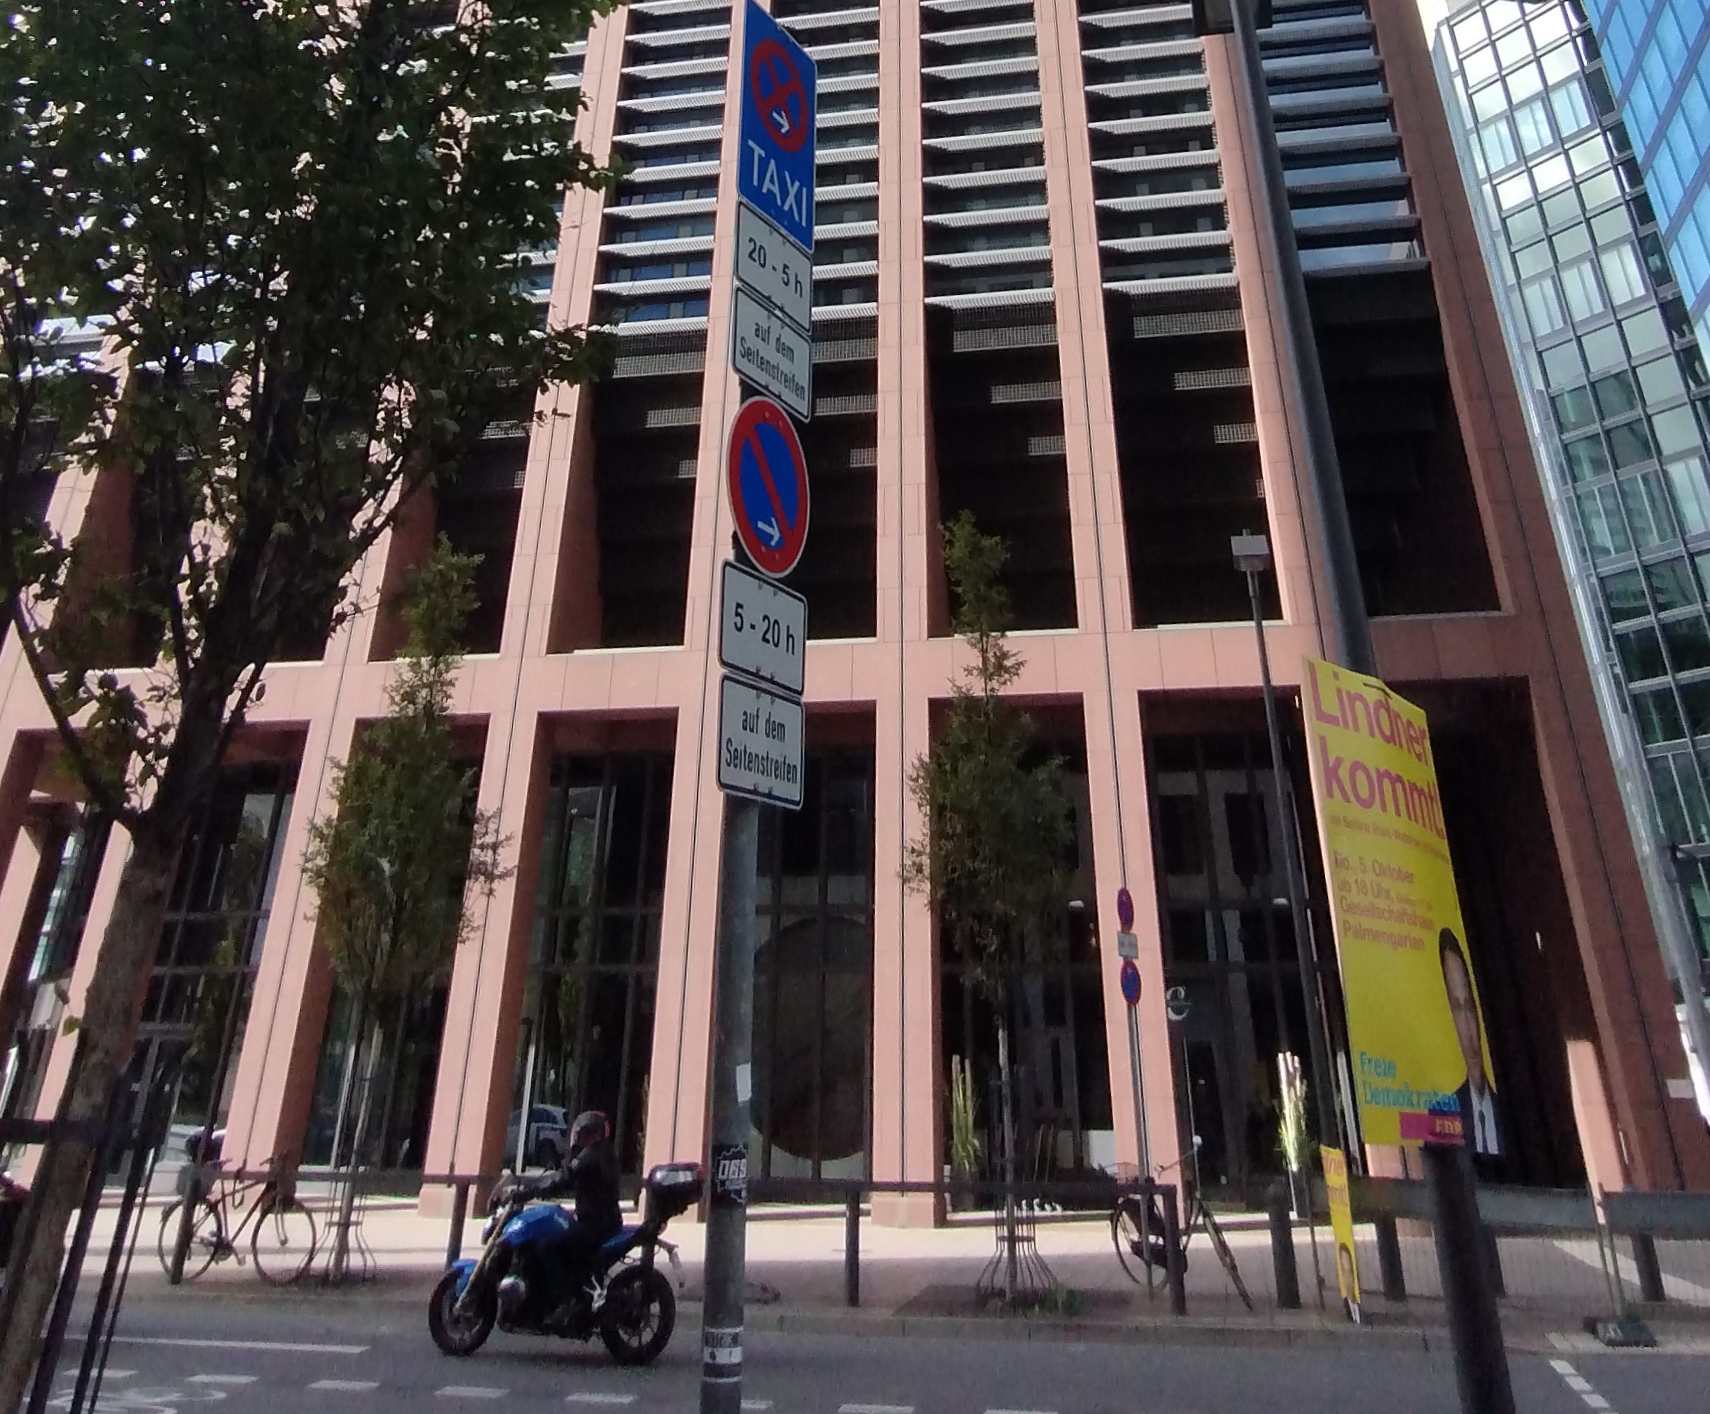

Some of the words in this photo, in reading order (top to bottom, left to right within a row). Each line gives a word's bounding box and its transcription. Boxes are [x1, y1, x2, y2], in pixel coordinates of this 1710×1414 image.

[747, 138, 807, 228] TAXI
[747, 236, 767, 269] 20
[781, 262, 791, 287] 5
[794, 271, 803, 299] h
[739, 335, 806, 403] Seitenstreifen
[754, 321, 772, 346] auf
[775, 332, 795, 365] dem
[733, 601, 745, 633] 5
[761, 613, 781, 649] 20
[785, 624, 796, 656] h
[741, 707, 760, 734] auf
[764, 711, 786, 743] dem
[1308, 661, 1429, 767] Lindner
[725, 737, 798, 785] Seitenstreifen
[1319, 734, 1446, 841] kommt!
[1355, 877, 1369, 897] 18
